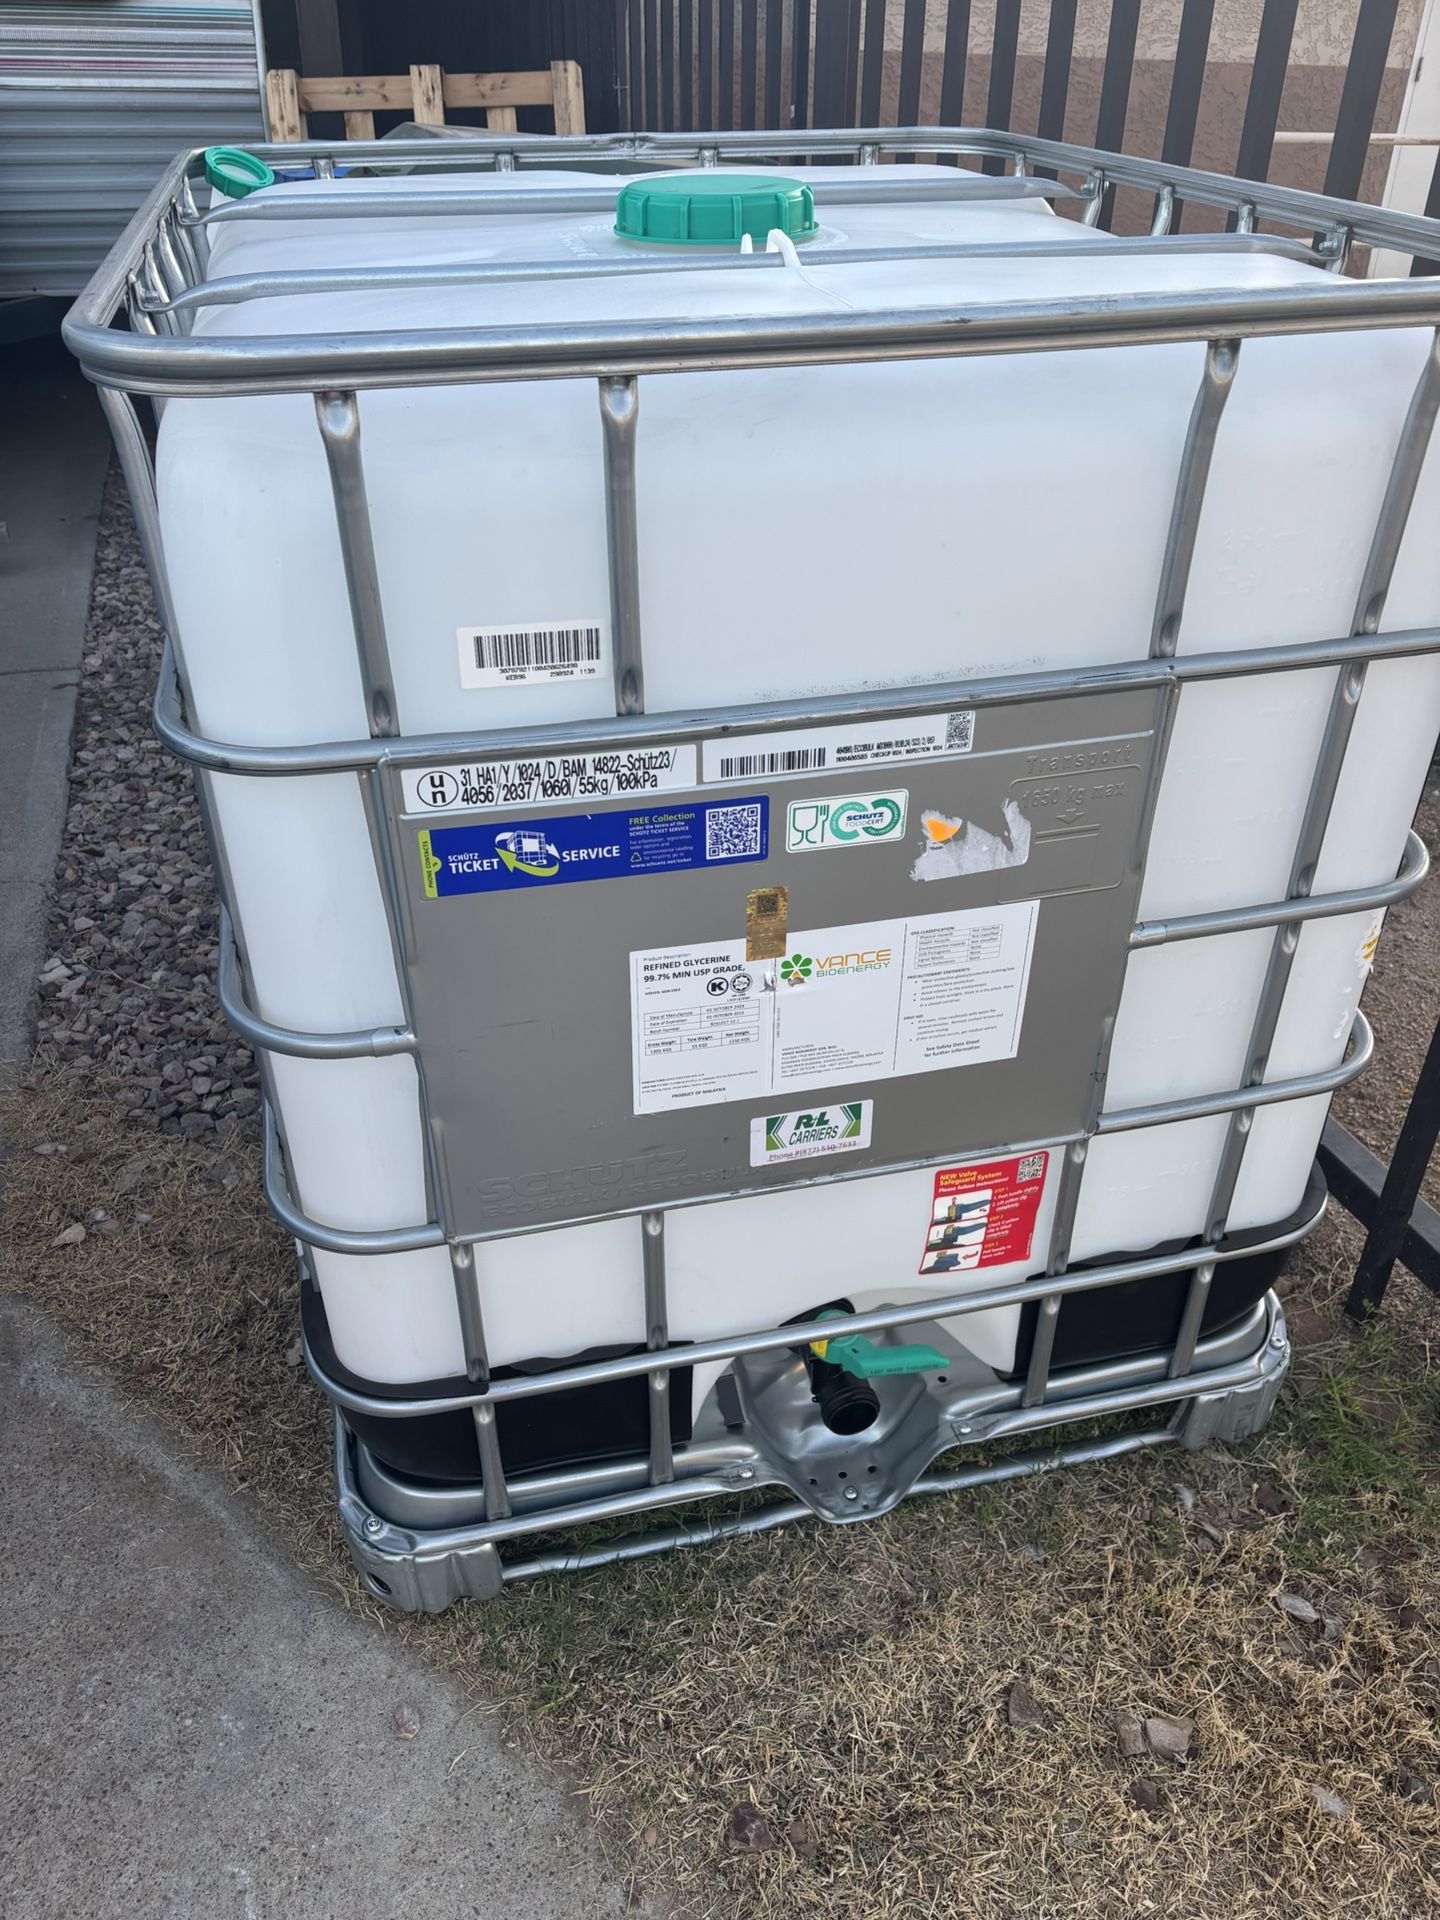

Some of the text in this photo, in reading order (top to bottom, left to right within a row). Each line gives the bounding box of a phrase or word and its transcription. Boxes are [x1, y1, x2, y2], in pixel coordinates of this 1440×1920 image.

[460, 768, 471, 787] 31
[629, 812, 696, 825] FREE Collection
[422, 840, 432, 869] CONTACTS
[447, 852, 479, 862] SCHÜTZ
[561, 845, 620, 862] SERVICE
[448, 858, 500, 874] TICKET
[643, 955, 731, 972] REFINED GLYCERINE
[815, 948, 892, 970] VANCE
[643, 964, 746, 983] 99.7% MIN USP GRADE,
[816, 961, 891, 978] BIOENERGY
[698, 1034, 713, 1042] Weight
[936, 1043, 952, 1051] Safety
[671, 1091, 694, 1099] PRODUCT
[702, 1086, 726, 1094] MALAYSIA
[788, 1125, 840, 1146] CARRIERS
[768, 1151, 795, 1162] Phone
[939, 1171, 1003, 1187] Safeguard System
